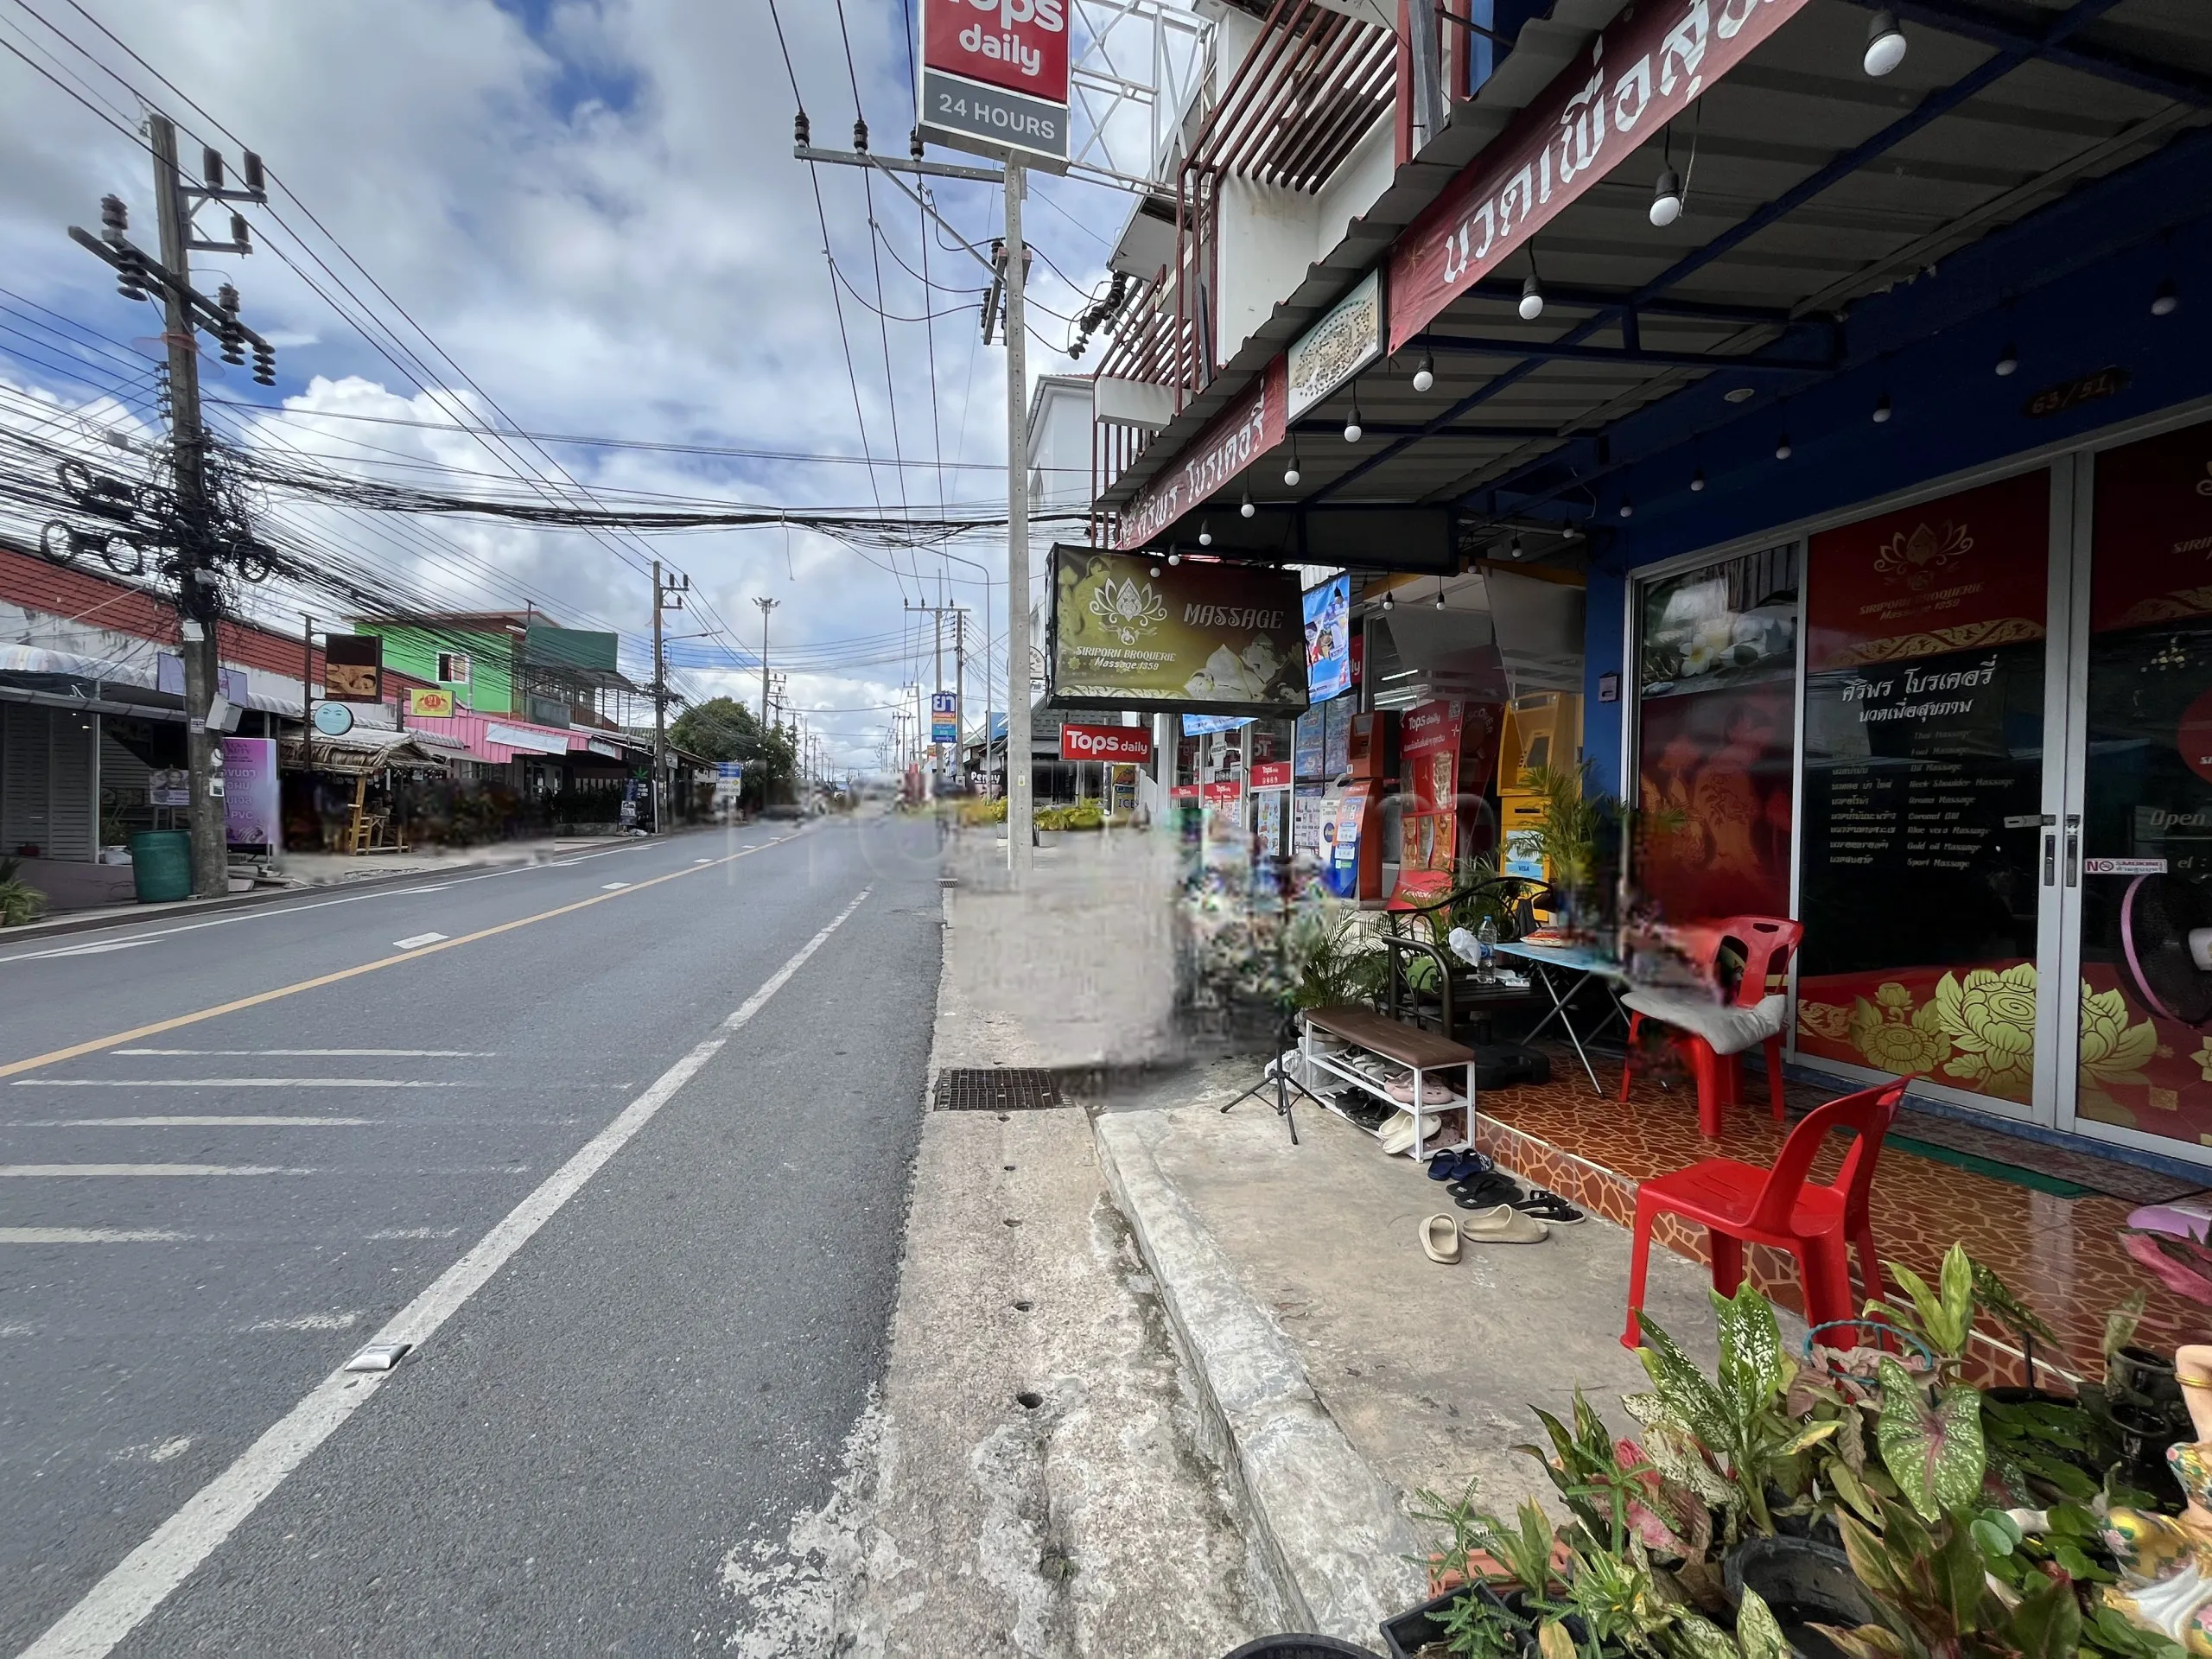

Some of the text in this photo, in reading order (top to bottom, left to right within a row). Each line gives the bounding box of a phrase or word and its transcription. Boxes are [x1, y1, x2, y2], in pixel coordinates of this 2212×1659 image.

[958, 23, 1040, 77] daily
[938, 92, 1055, 140] 24 HOURS
[1183, 603, 1284, 630] MASSAGE
[1076, 646, 1177, 662] SIRIPORN BROQUERIE
[1094, 656, 1137, 671] Massage
[1841, 677, 1894, 702] ศิริพร
[932, 695, 956, 712] ยา
[1859, 696, 1974, 723] นวดเพื่อสุขภาพ
[1408, 714, 1427, 732] Tops
[1066, 730, 1147, 755] Tops daily
[1926, 763, 1962, 774] Massage
[1932, 779, 1972, 788] Shoulder
[1975, 778, 2015, 788] Massage
[1938, 796, 1977, 805] Massage
[231, 810, 253, 819] PVC
[2150, 809, 2207, 831] Open
[1907, 841, 1926, 851] Gold
[1943, 842, 1982, 854] Massage
[1907, 857, 1971, 871] Sport Massage
